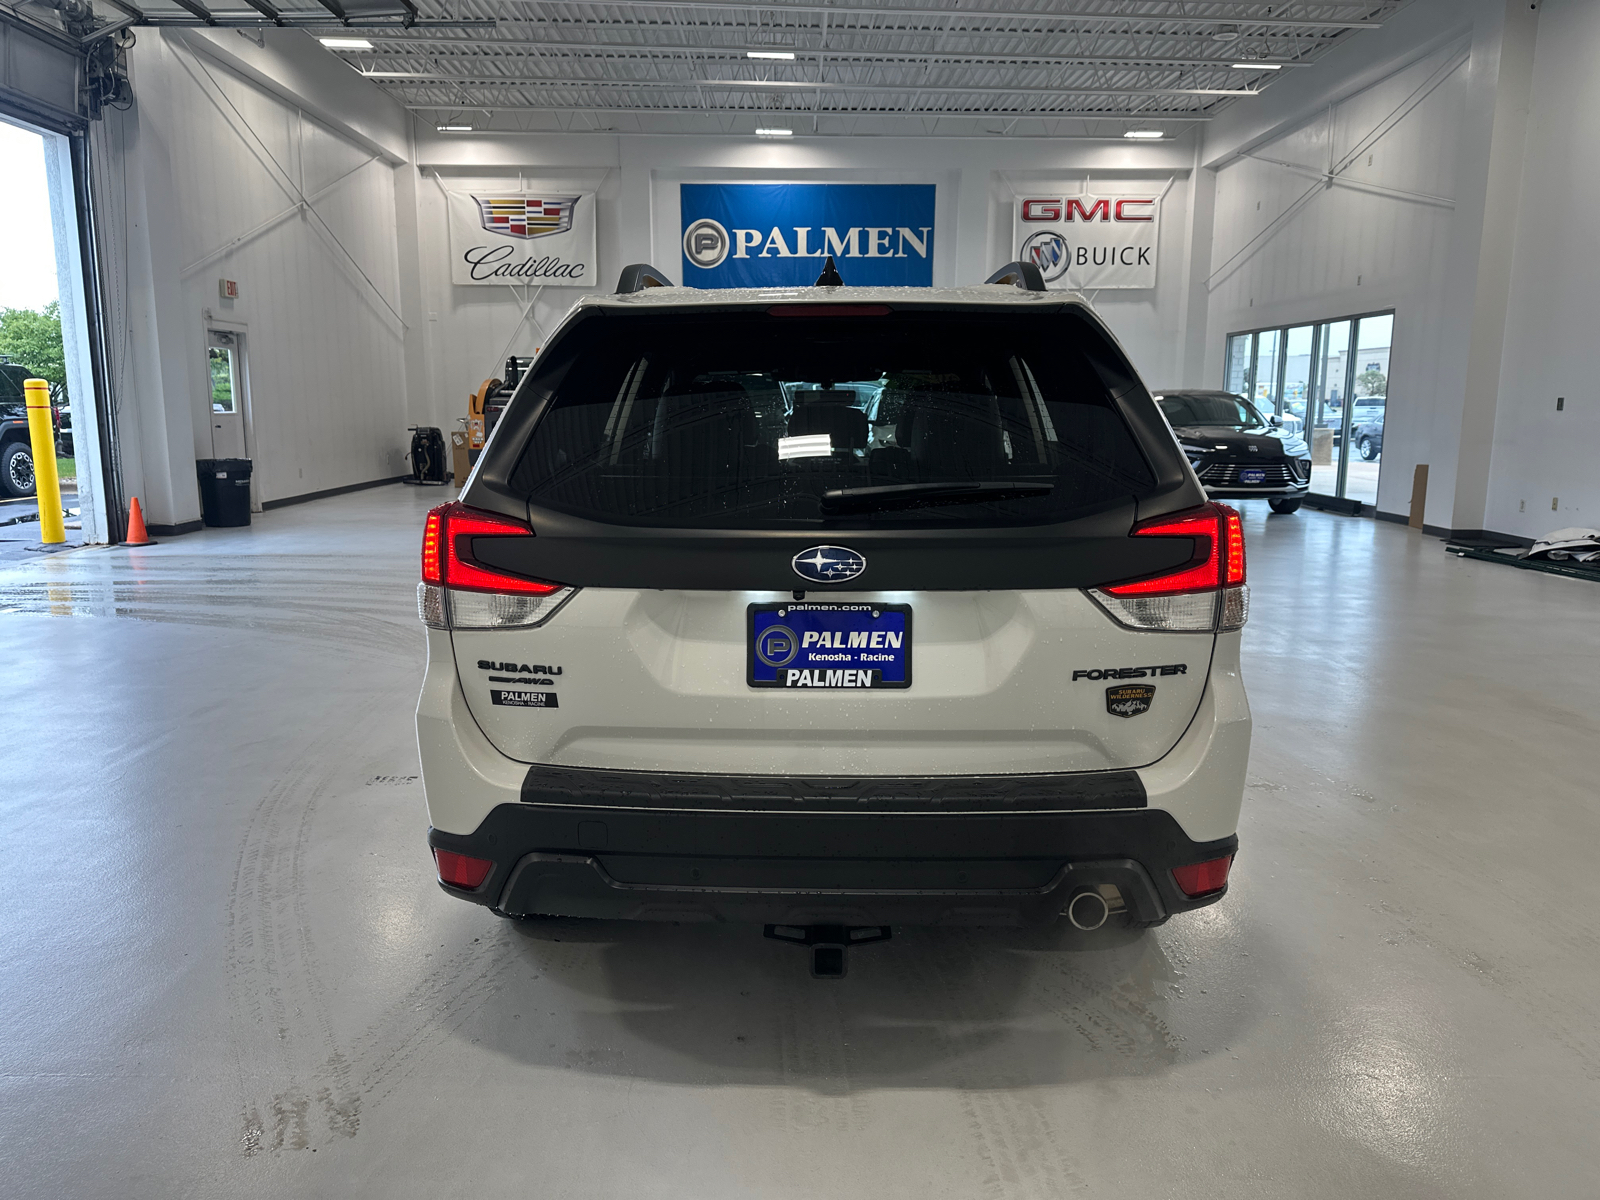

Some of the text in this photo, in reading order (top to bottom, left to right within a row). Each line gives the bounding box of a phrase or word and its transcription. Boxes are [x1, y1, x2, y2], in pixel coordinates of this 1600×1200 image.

[1021, 197, 1155, 222] GMC
[731, 226, 932, 259] PALMEN
[464, 245, 585, 280] Cadillac
[1076, 246, 1151, 266] BUICK
[226, 280, 237, 296] EXIT
[787, 604, 872, 612] palmen.com
[801, 631, 903, 649] PALMEN
[808, 652, 852, 662] Kenosha
[860, 652, 895, 662] Racine
[477, 659, 563, 675] SUBARU
[1071, 663, 1188, 682] FORESTER
[512, 677, 554, 685] AWD
[786, 669, 872, 687] PALMEN
[501, 691, 546, 702] PALMEN
